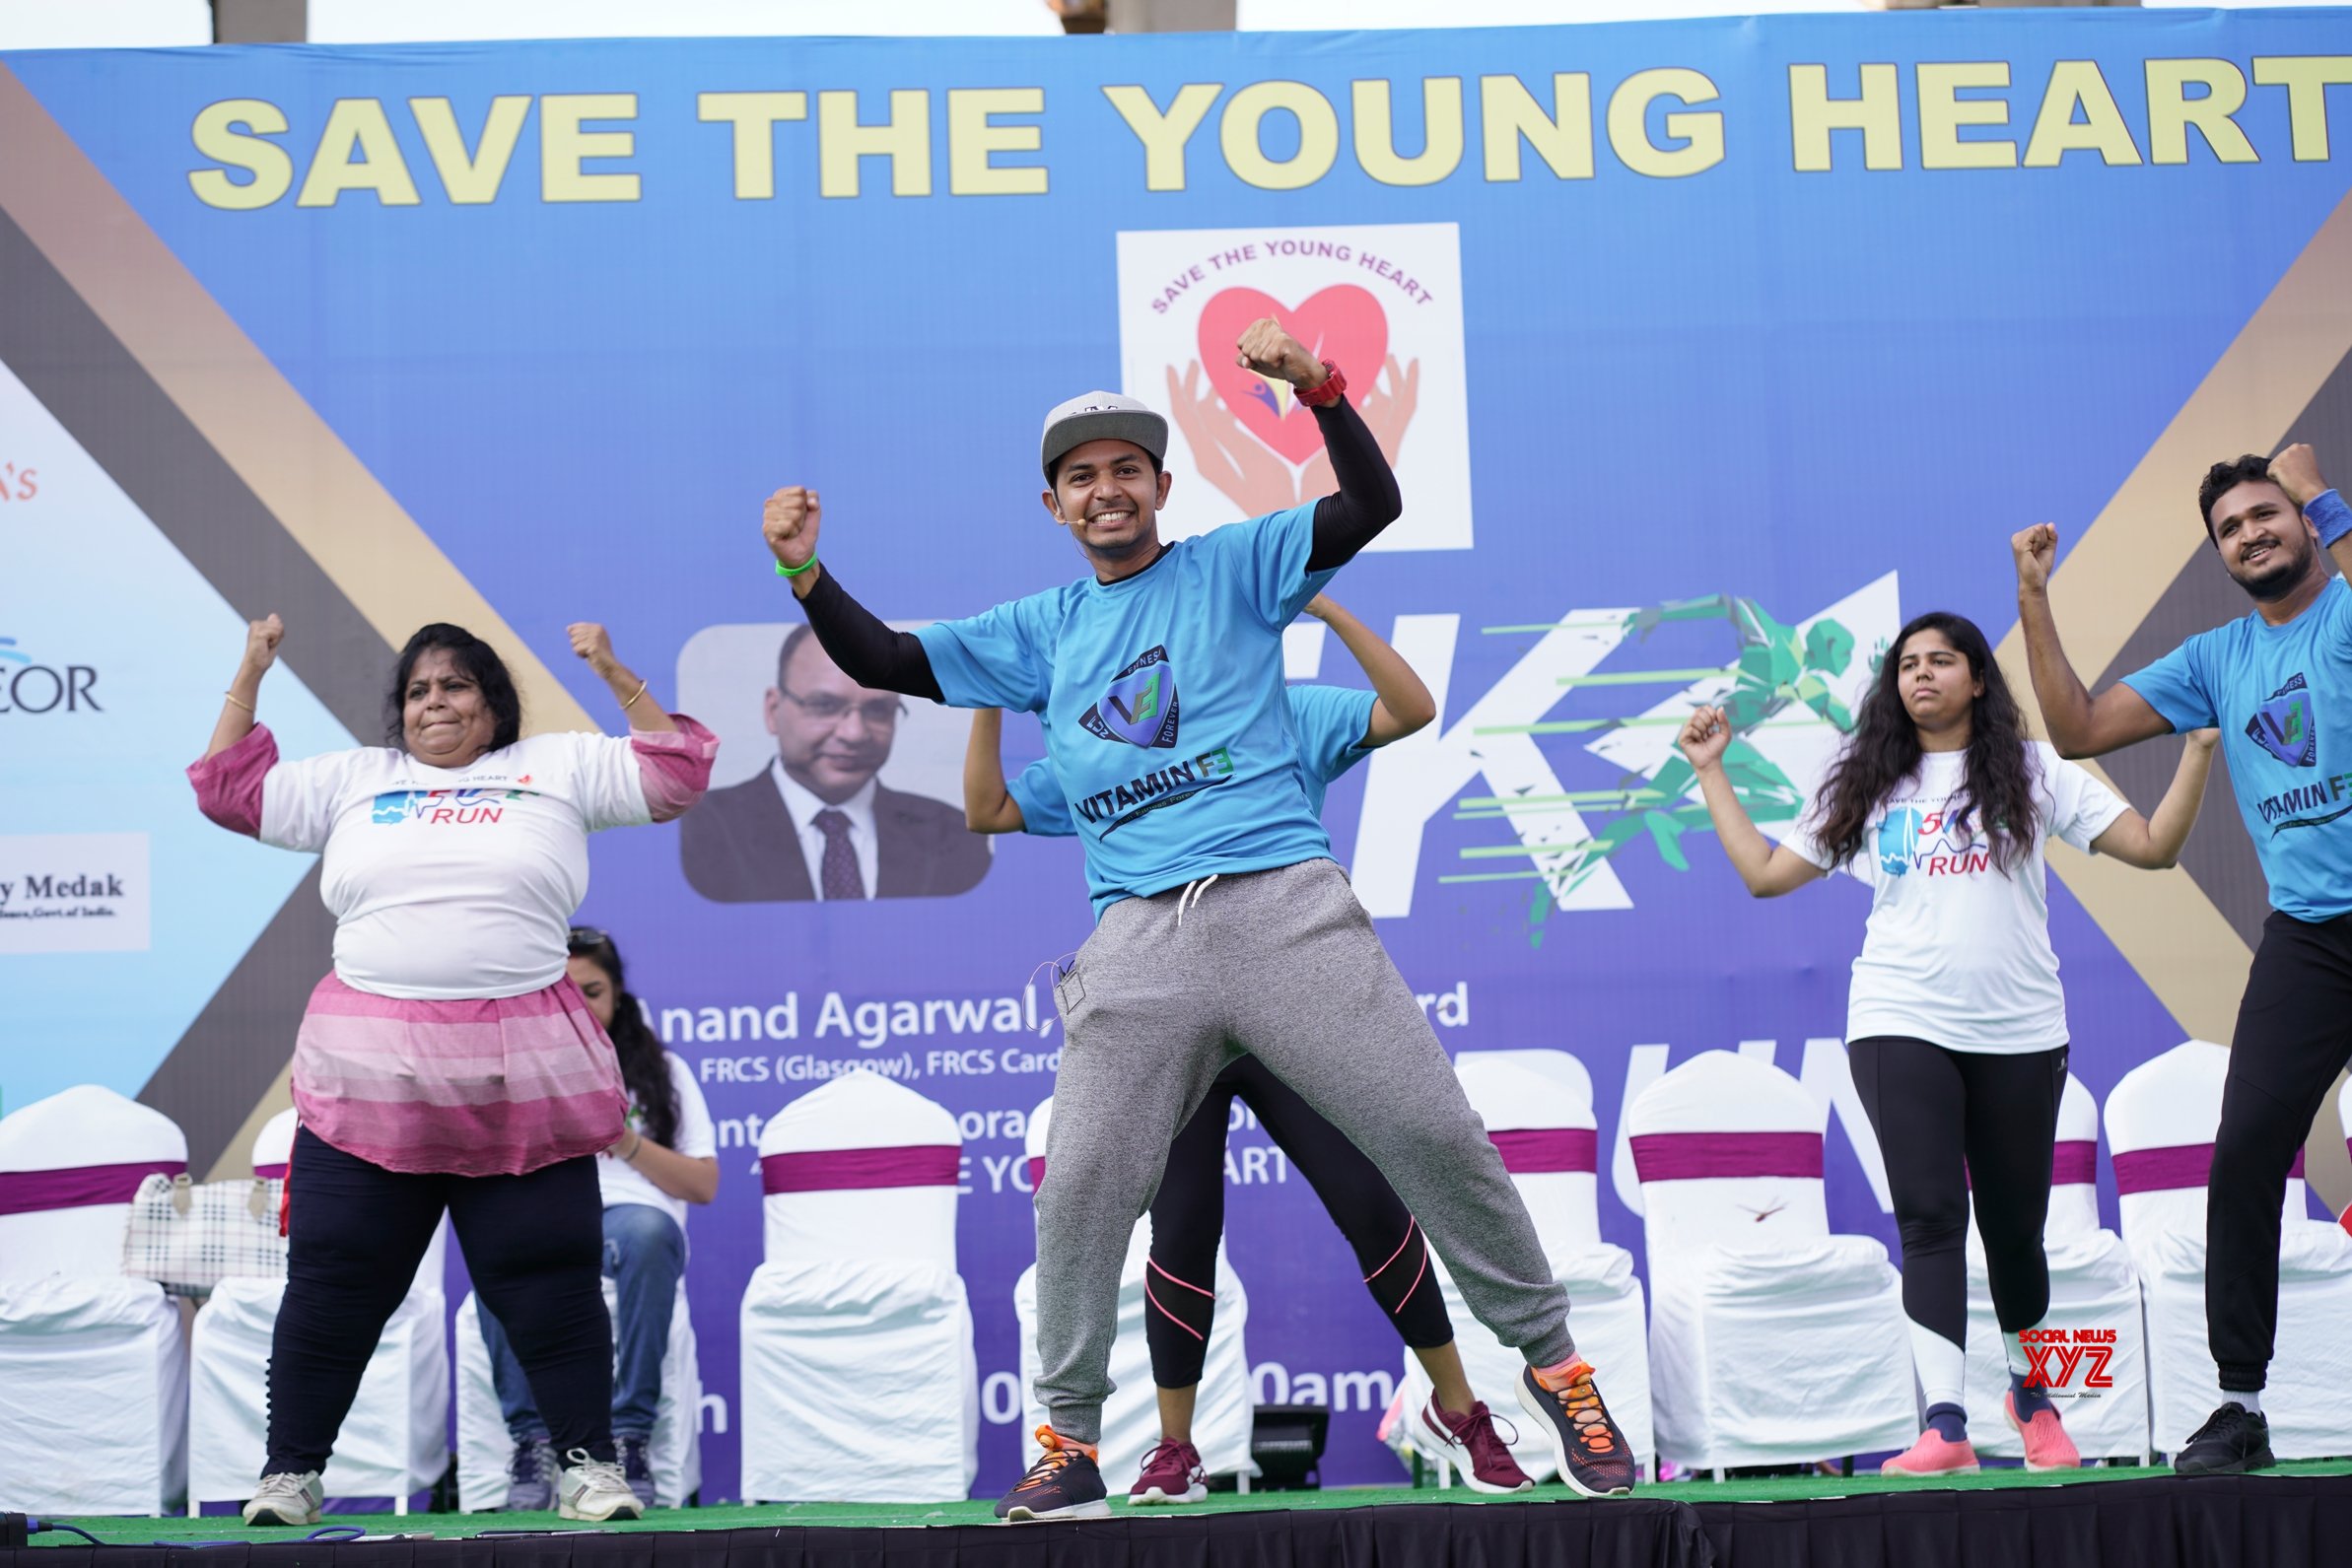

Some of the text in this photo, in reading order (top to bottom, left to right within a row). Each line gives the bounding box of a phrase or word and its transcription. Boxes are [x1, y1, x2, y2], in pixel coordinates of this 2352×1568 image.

[187, 55, 2352, 211] SAVE THE YOUNG HEART
[1151, 239, 1433, 314] SAVE THE YOUNG HEART
[1074, 761, 1196, 823] VITAMIN
[431, 808, 504, 824] RUN
[25, 873, 123, 898] Medak
[1928, 852, 1990, 876] RUN
[637, 991, 798, 1044] nand
[814, 984, 1053, 1049] Agarwal,
[701, 1056, 769, 1083] FRCS
[927, 1050, 994, 1076] FRCS
